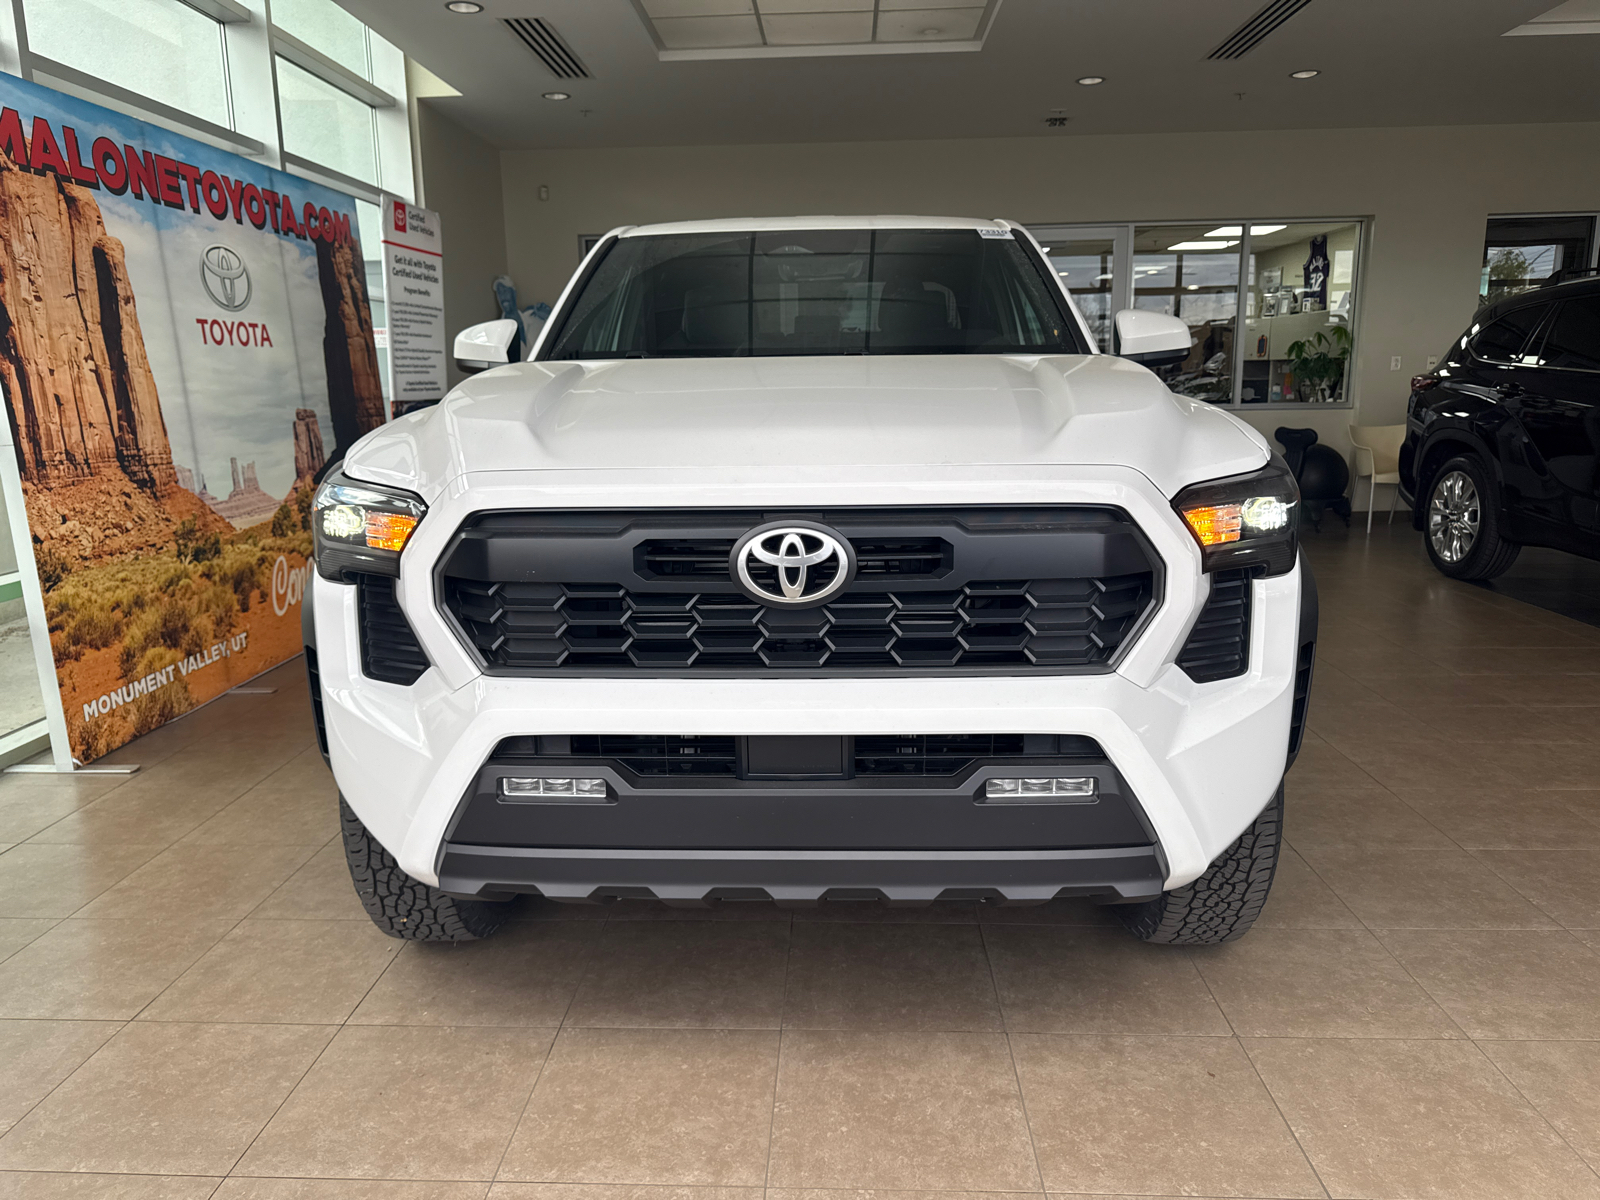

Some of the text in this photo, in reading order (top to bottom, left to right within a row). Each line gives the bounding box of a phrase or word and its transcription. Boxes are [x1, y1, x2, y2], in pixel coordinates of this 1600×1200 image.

[1310, 272, 1324, 292] 32
[196, 318, 273, 348] TOYOTA
[82, 632, 247, 722] MONUMENT VALLEY, UT
